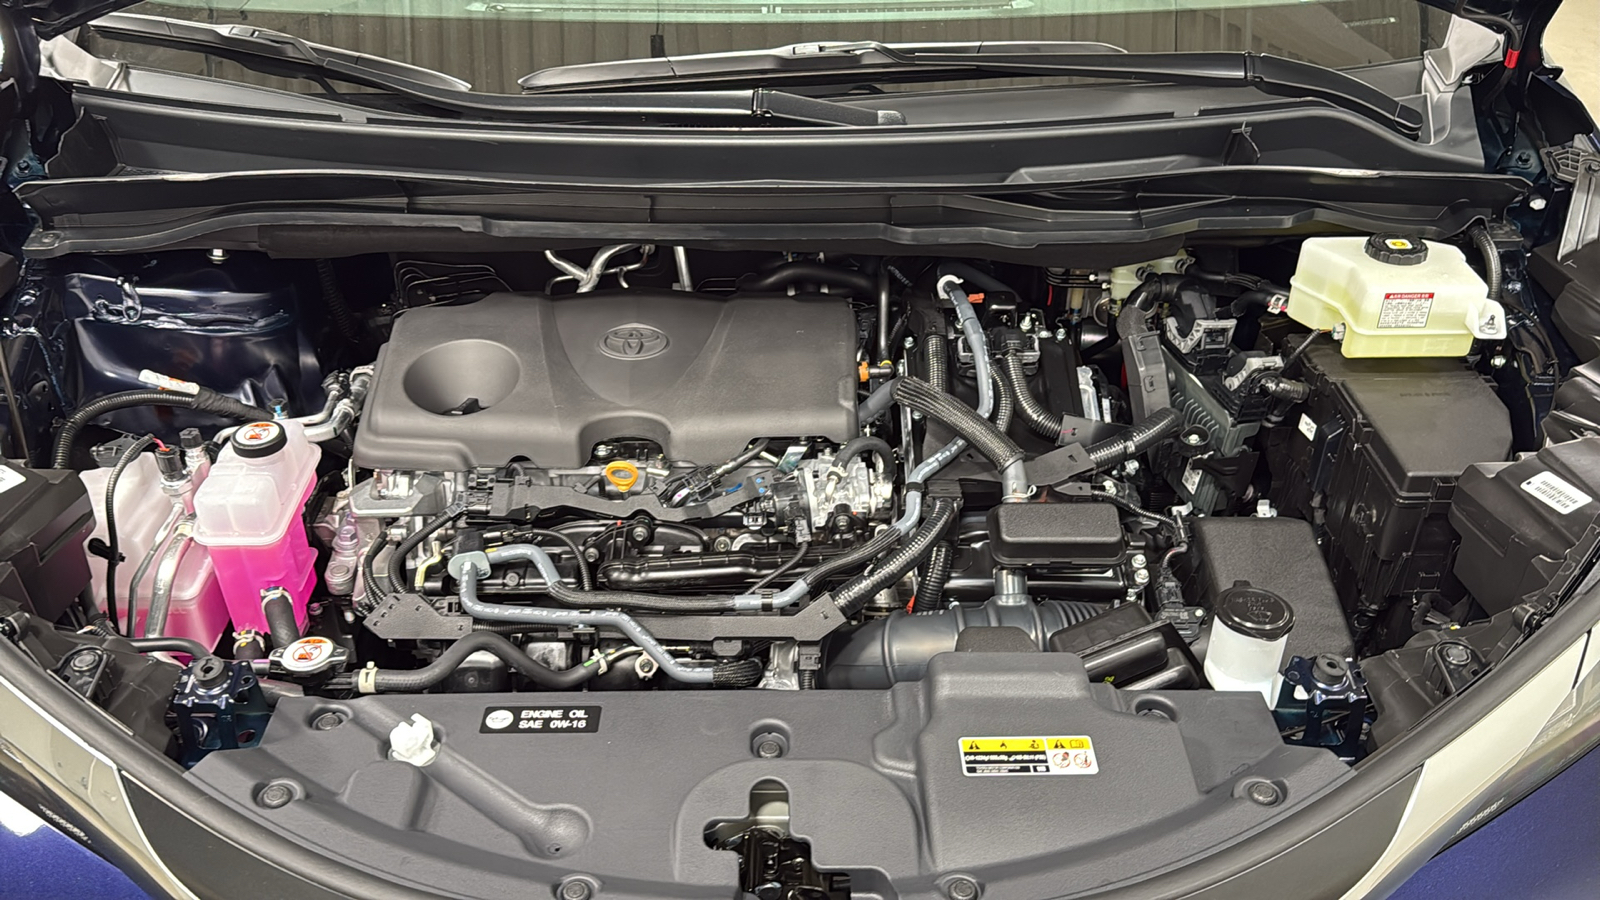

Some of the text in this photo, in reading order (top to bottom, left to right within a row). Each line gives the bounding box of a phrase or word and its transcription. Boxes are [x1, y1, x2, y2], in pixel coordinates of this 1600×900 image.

[520, 709, 588, 718] ENGINE OIL
[518, 719, 586, 728] SAE 0W-16
